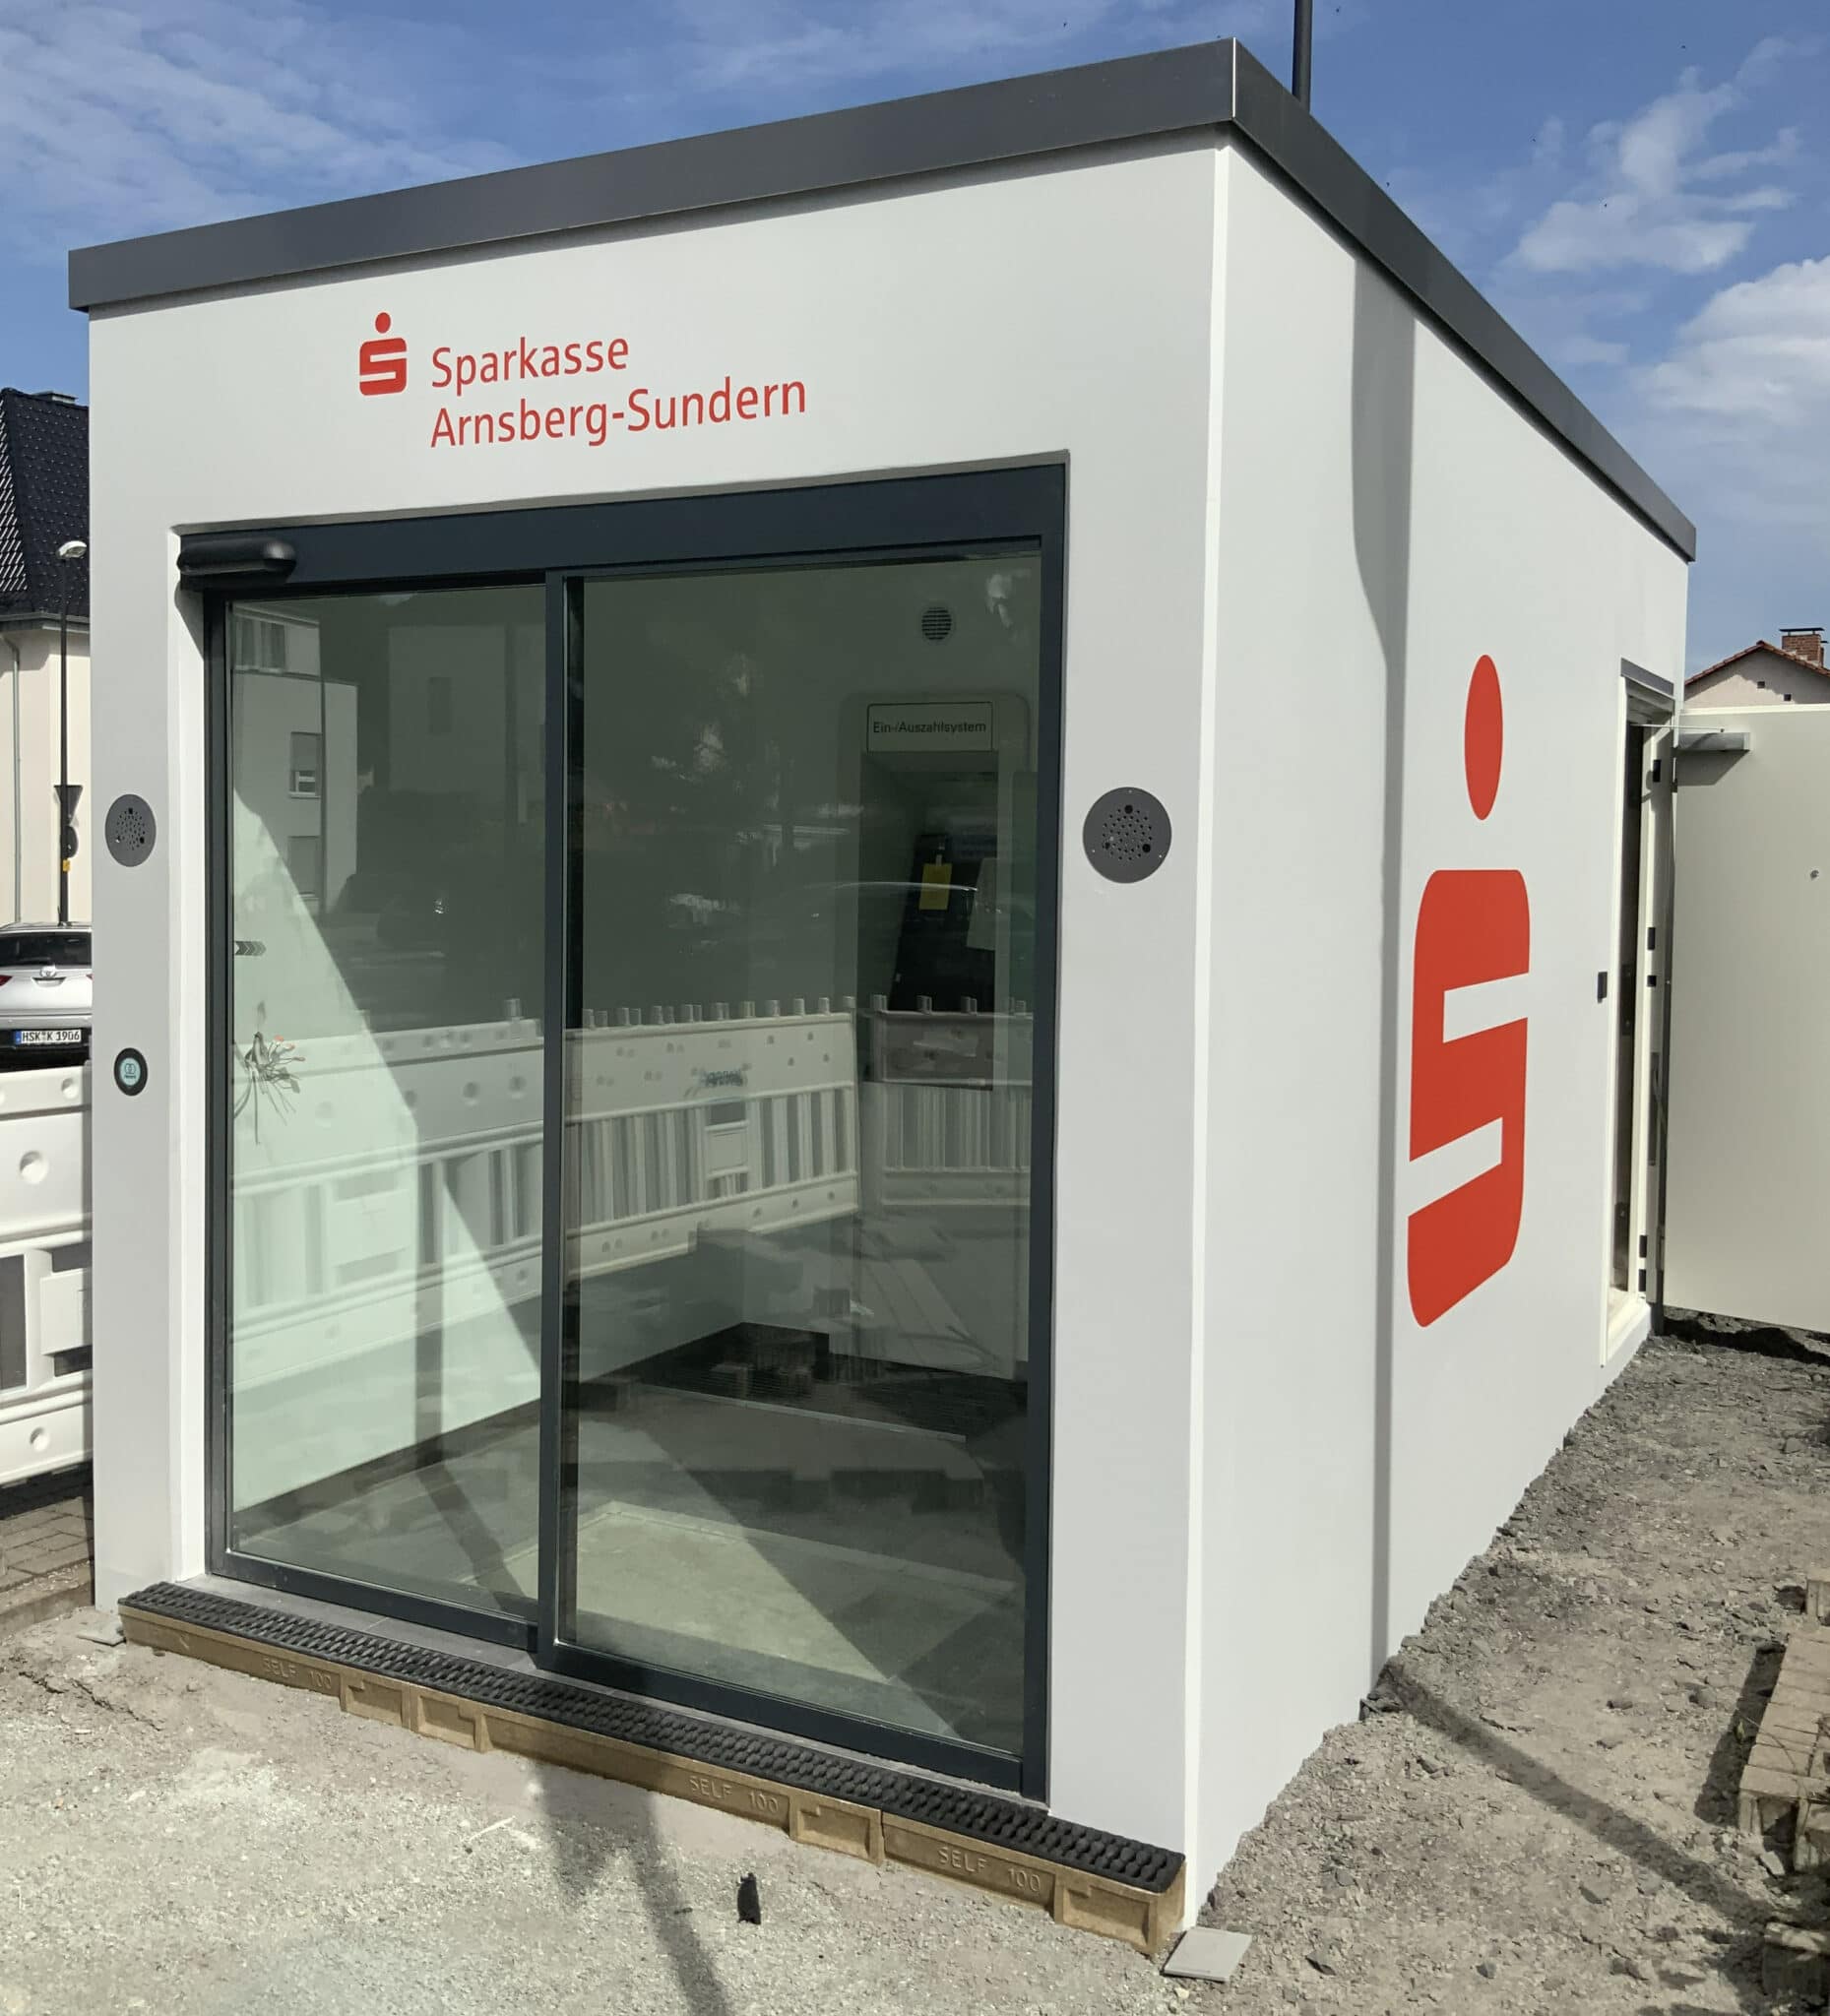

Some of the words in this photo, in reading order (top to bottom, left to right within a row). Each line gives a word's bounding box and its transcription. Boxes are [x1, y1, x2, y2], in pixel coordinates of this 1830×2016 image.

[431, 336, 630, 397] Sparkasse
[430, 375, 807, 448] Arnsberg-Sundern
[872, 721, 987, 736] Ein-/Auszahlsystem
[22, 1031, 41, 1041] HSK
[56, 1030, 80, 1041] 1906
[688, 1776, 733, 1799] SELF
[747, 1792, 780, 1814] 100
[937, 1846, 988, 1872] SELF
[1007, 1868, 1041, 1894] 100
